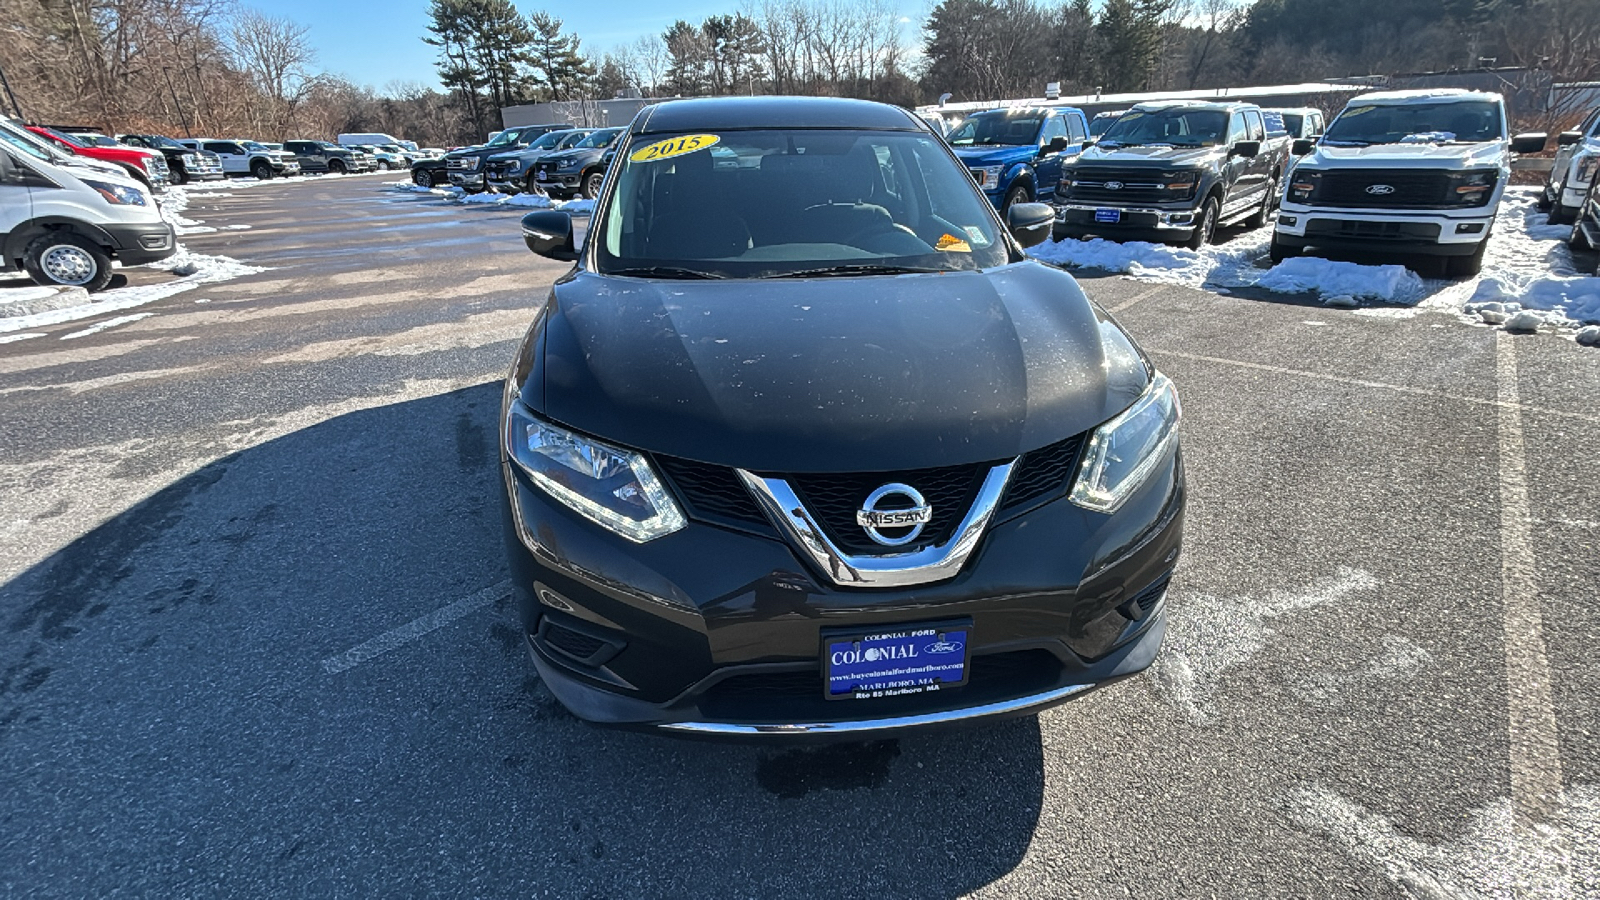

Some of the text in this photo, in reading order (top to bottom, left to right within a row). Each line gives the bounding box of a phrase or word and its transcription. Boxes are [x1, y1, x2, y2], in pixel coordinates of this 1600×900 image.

[645, 136, 702, 160] 2015
[867, 512, 926, 523] NISSAN
[864, 629, 936, 642] COLONIAL FORD
[831, 644, 918, 666] COLONIAL
[830, 663, 964, 682] www.buycolonialfordmarlboro.com
[918, 678, 934, 686] MA
[856, 691, 870, 699] Rte
[885, 687, 922, 697] Marlboro
